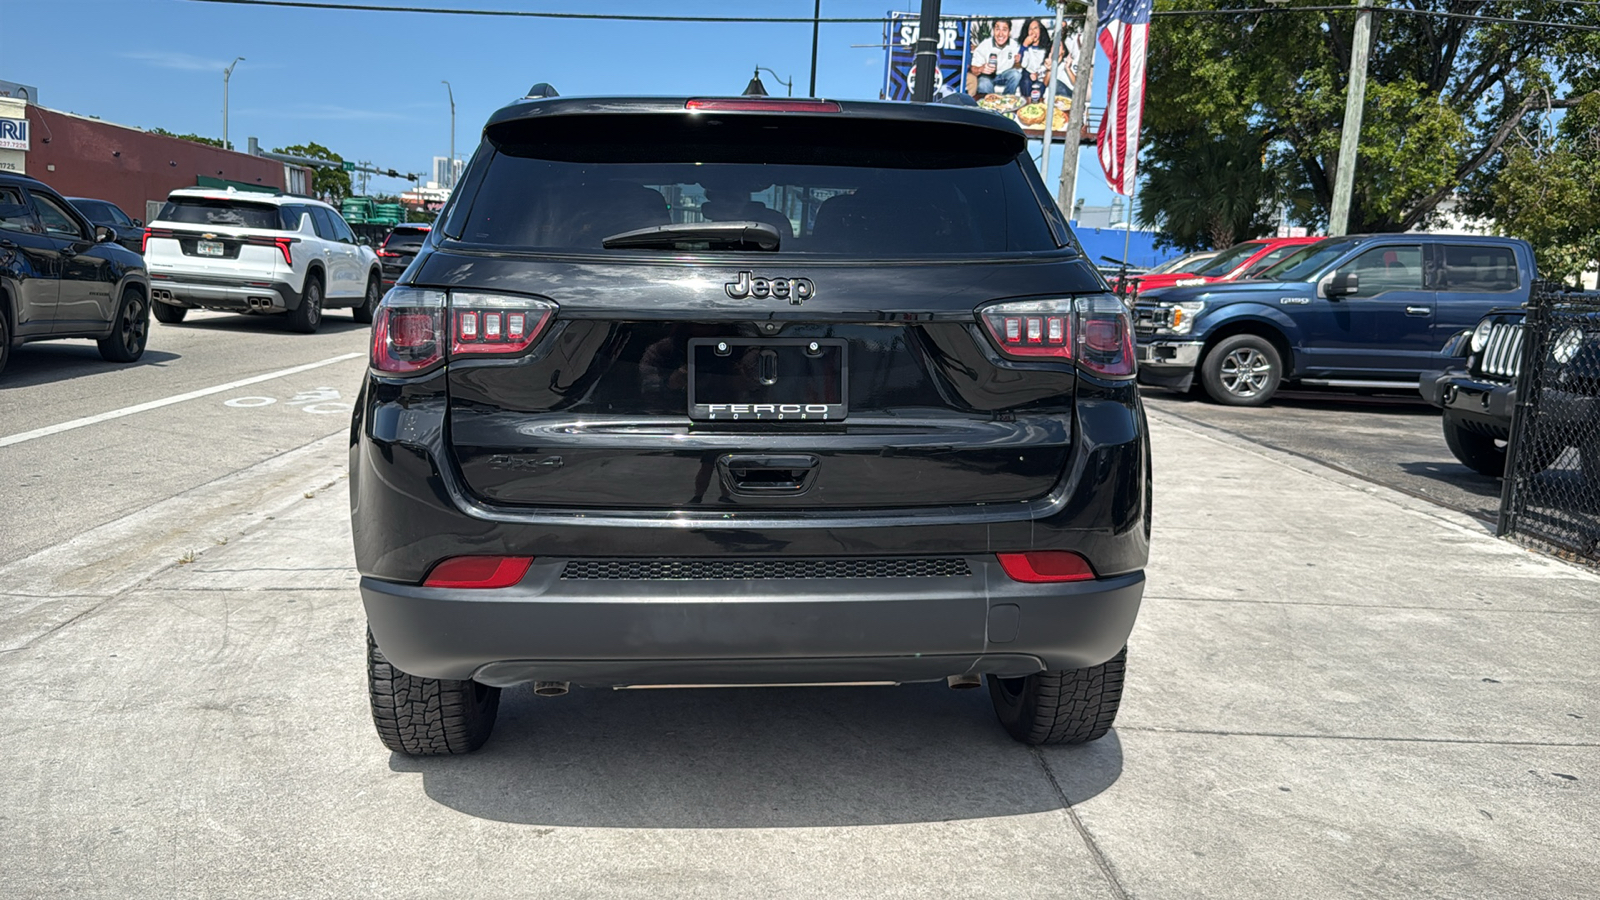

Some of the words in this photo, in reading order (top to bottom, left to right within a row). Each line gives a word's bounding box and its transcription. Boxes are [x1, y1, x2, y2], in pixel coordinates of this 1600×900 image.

[900, 26, 957, 50] SAOR
[725, 270, 816, 305] Jeep
[708, 403, 828, 413] FERCO
